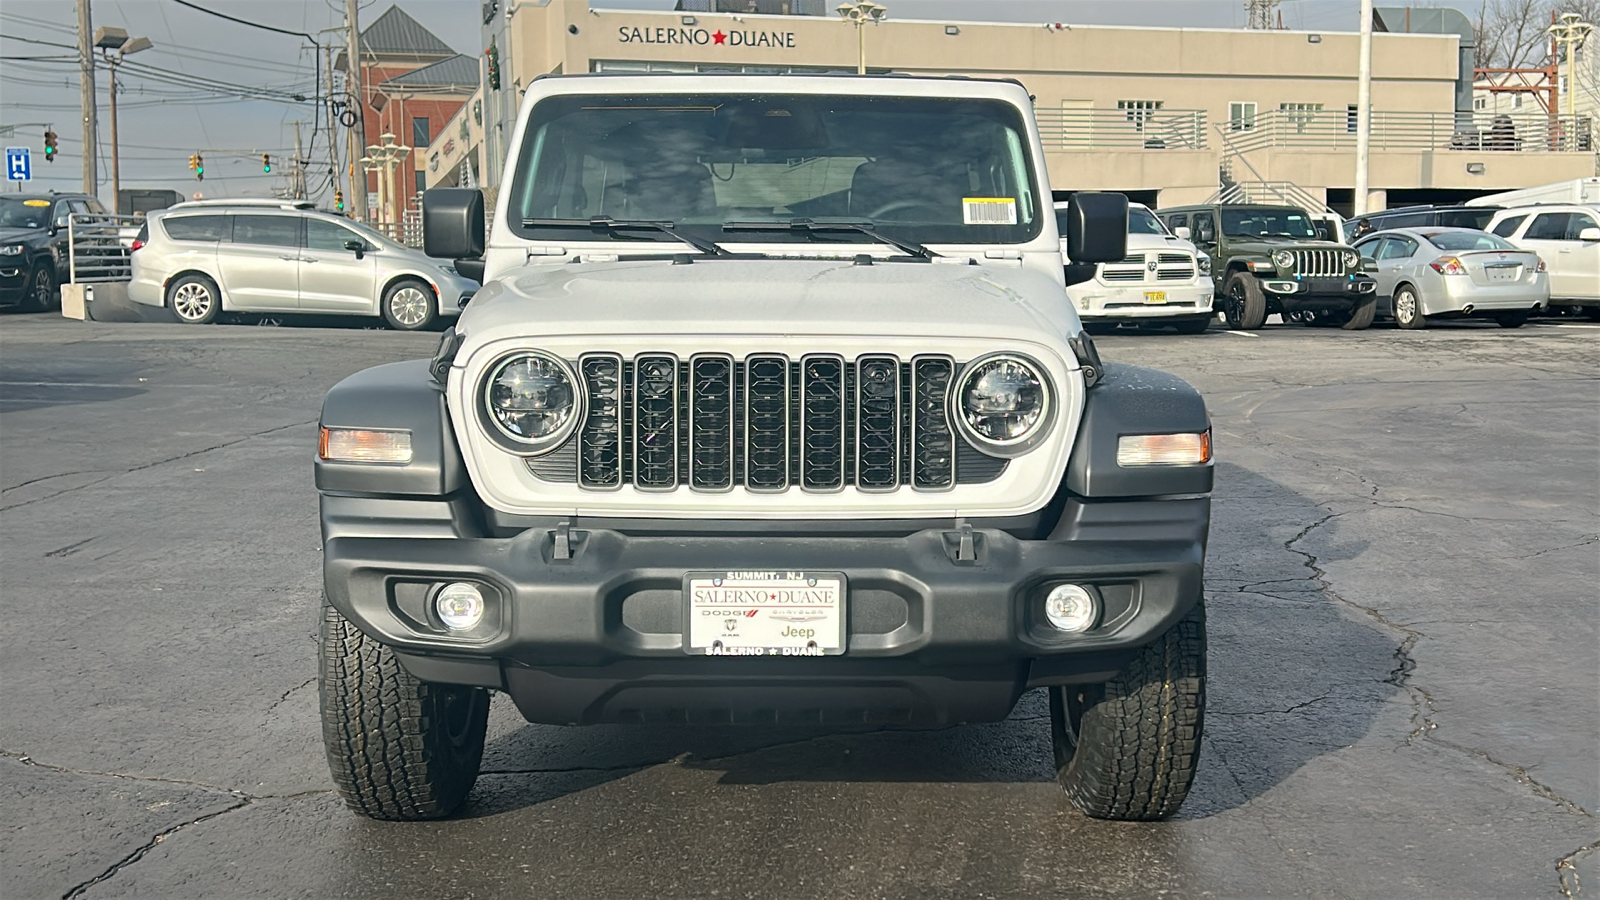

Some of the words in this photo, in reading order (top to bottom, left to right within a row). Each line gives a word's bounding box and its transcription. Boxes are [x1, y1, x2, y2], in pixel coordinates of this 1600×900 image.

[618, 26, 710, 46] SALERNO
[729, 30, 796, 48] DUANE
[12, 155, 26, 172] H
[726, 571, 780, 581] SUMMIT,
[786, 571, 804, 581] NJ
[694, 590, 769, 604] SALERNO
[777, 590, 835, 604] DUANE
[781, 625, 815, 639] Jeep
[705, 646, 764, 656] SALERNO
[782, 647, 825, 657] DUANE
